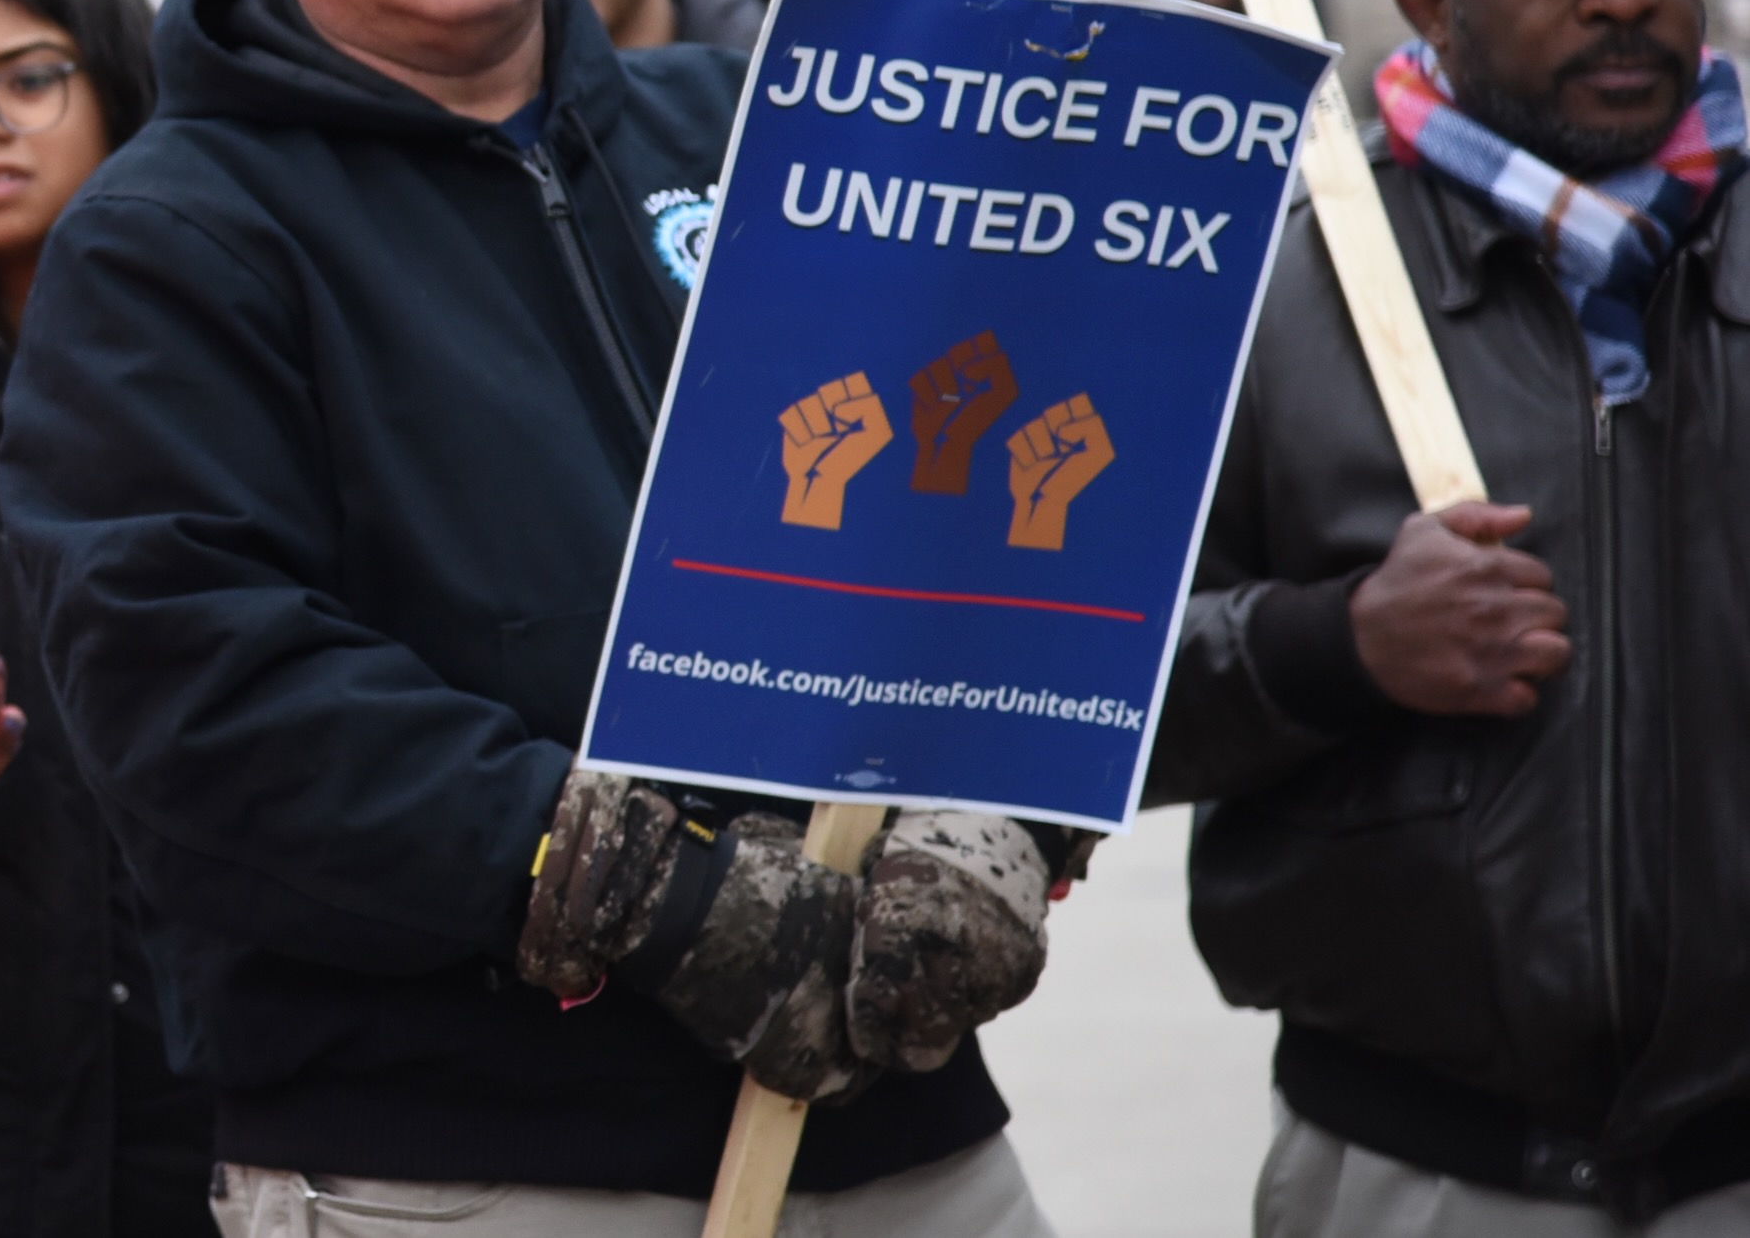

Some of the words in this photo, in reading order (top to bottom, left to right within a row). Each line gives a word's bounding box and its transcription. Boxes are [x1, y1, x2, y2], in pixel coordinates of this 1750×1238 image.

[767, 46, 1108, 142] JUSTICE
[1123, 86, 1298, 167] FOR
[781, 162, 1076, 254] UNITED
[1093, 200, 1231, 273] SIX
[626, 642, 1145, 732] facebook.com/JusticeForUnitedSix
